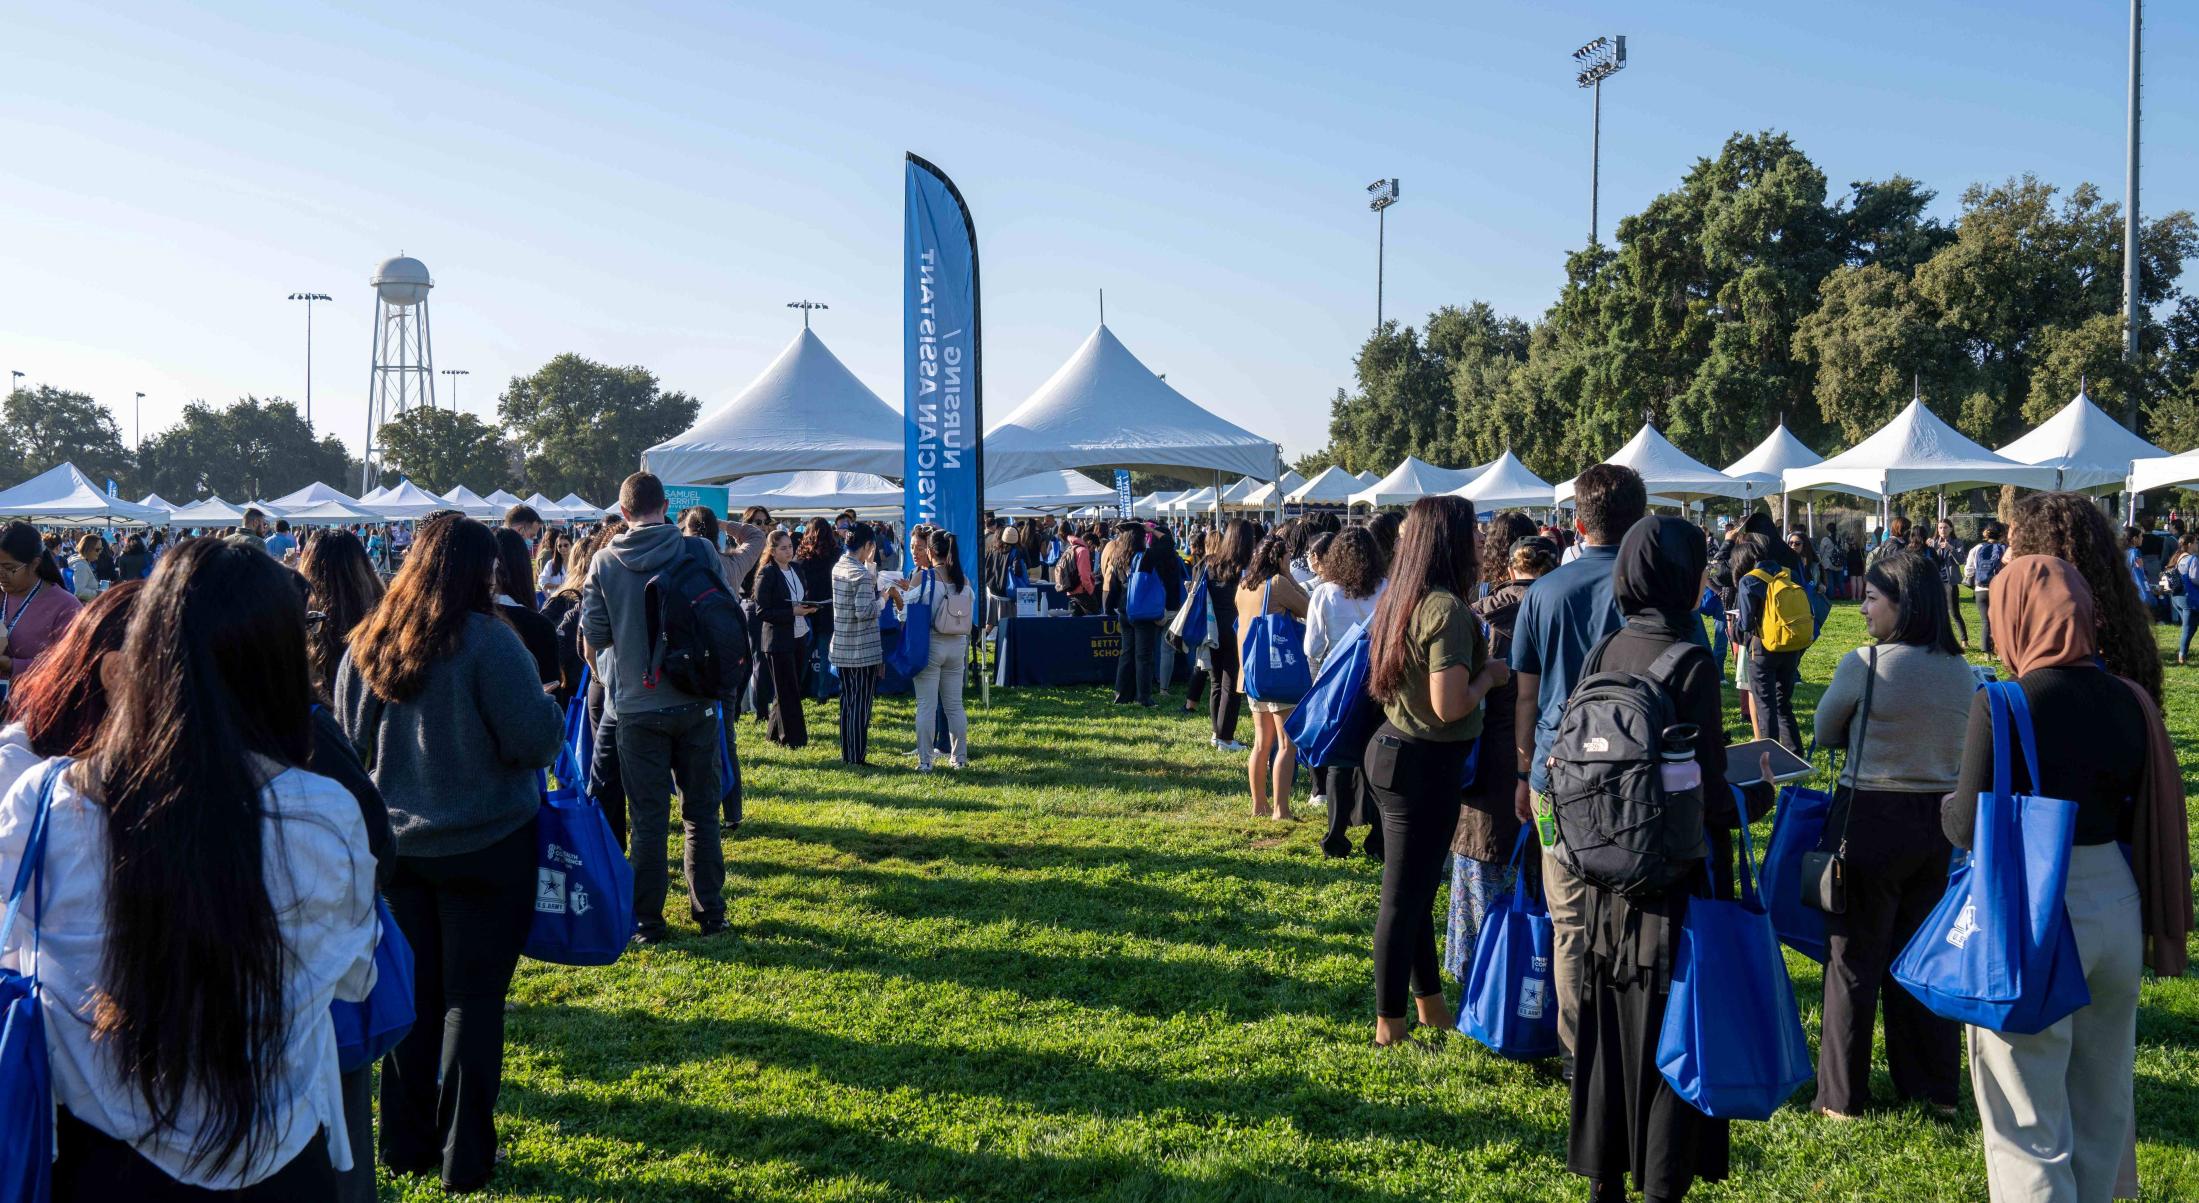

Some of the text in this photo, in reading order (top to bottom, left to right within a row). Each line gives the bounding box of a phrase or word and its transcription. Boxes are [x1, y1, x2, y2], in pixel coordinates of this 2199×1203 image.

[664, 490, 702, 499] SAMUEL
[1091, 639, 1119, 648] BETTY
[1093, 649, 1120, 657] SCHO
